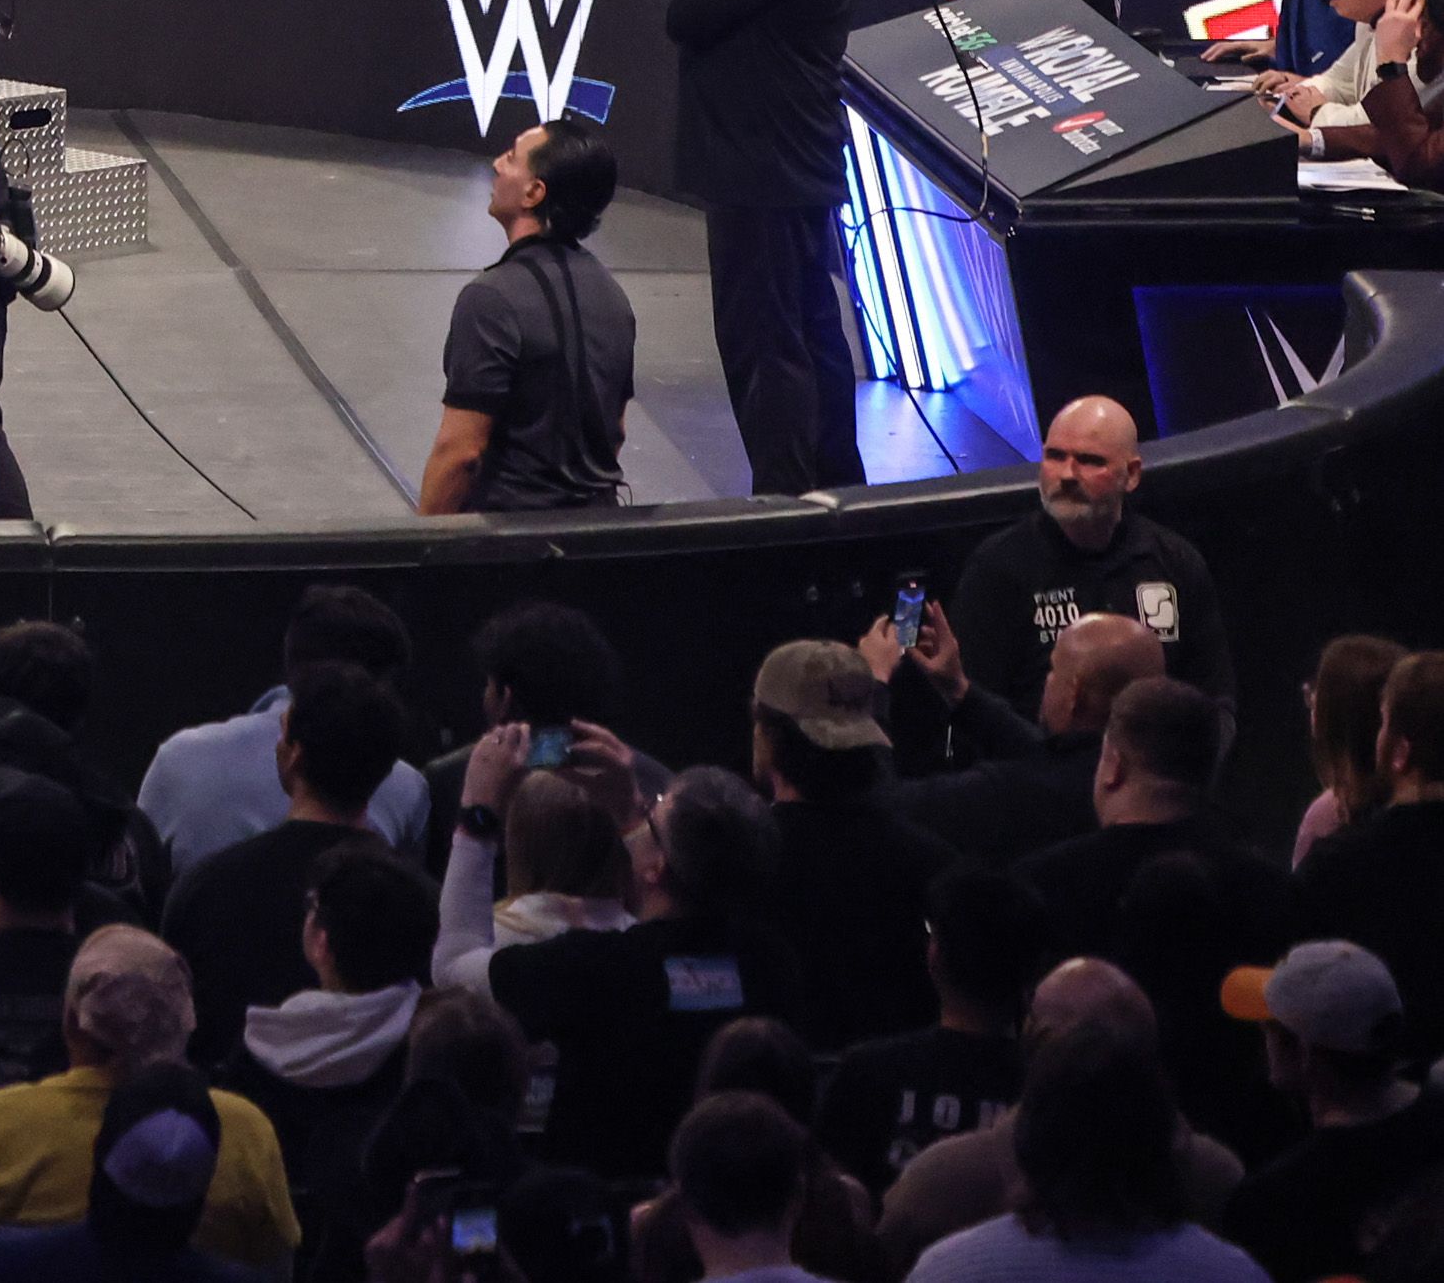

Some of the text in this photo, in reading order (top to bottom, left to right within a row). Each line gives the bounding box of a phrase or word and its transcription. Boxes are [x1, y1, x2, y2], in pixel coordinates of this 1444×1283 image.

[918, 63, 1051, 138] RUMBLE
[1026, 34, 1142, 105] ROYAL
[1032, 602, 1081, 632] 4010
